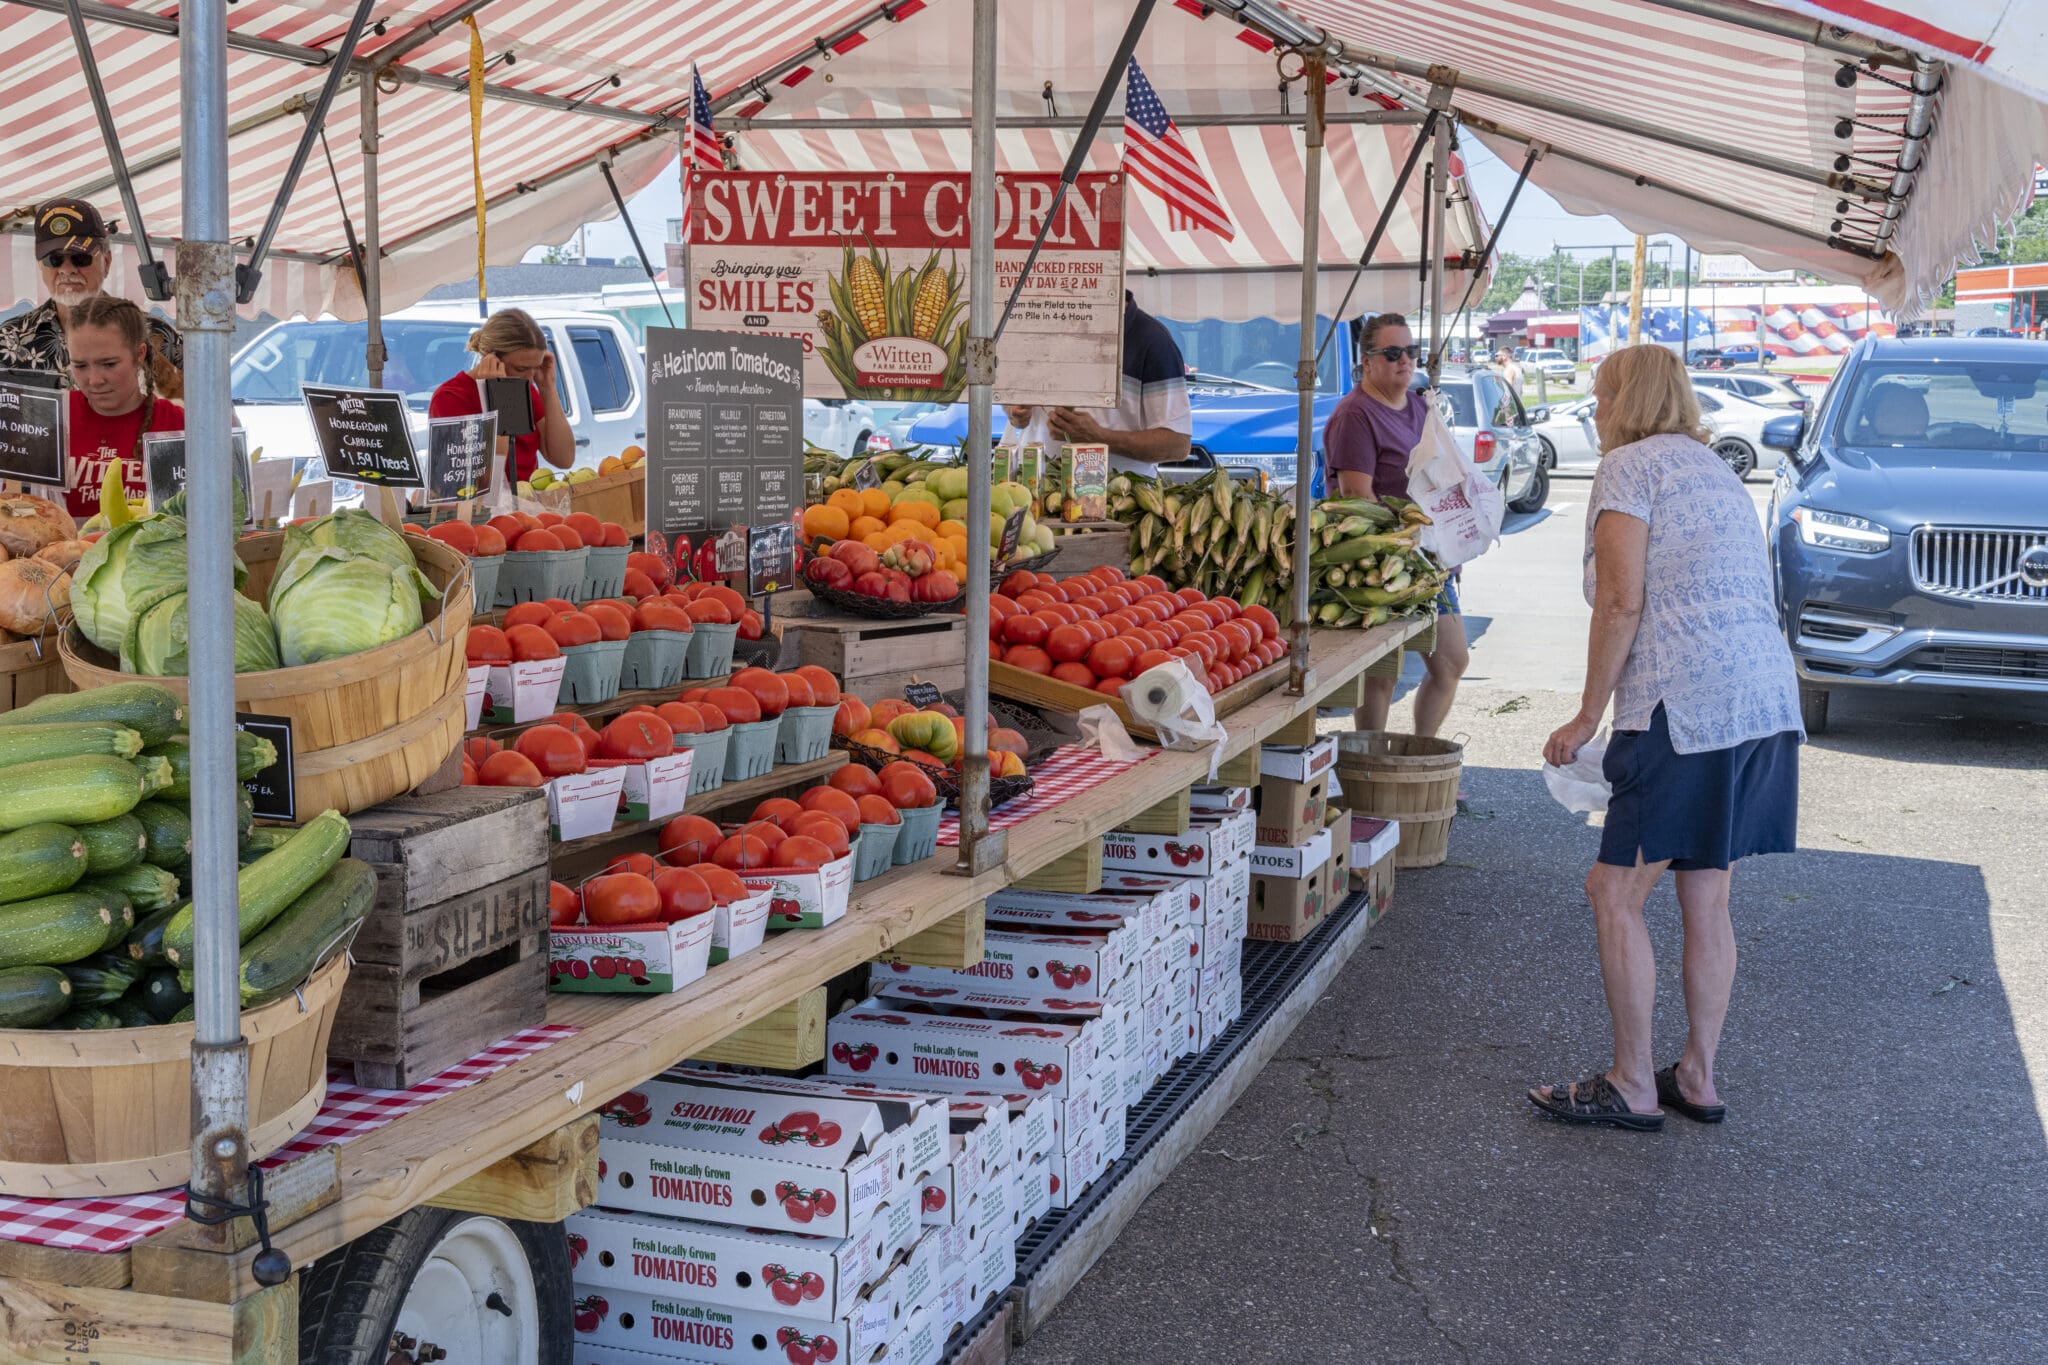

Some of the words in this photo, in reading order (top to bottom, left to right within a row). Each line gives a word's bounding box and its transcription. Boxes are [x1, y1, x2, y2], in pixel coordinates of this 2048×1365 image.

[703, 178, 906, 242] SWEET
[711, 260, 775, 278] Bringing
[776, 266, 802, 278] you
[1029, 262, 1066, 274] ICKED
[1068, 263, 1103, 274] FRESH
[1037, 277, 1058, 289] DAY
[1071, 278, 1078, 289] 2
[1080, 277, 1098, 289] AM
[699, 280, 814, 313] SMILES
[1004, 300, 1026, 308] Fom
[1028, 300, 1041, 309] the
[1044, 300, 1064, 309] Field
[1067, 301, 1076, 309] to
[1079, 301, 1092, 309] the
[747, 317, 766, 325] AND
[1025, 311, 1040, 320] Pile
[1043, 312, 1050, 320] in
[1052, 312, 1066, 320] 4-6
[1069, 312, 1093, 320] Hours
[872, 345, 933, 363] Witten
[663, 347, 726, 378] Heirloom
[730, 346, 791, 383] Tomatoes
[877, 374, 931, 385] Greenhouse
[0, 393, 19, 404] ITTEN
[668, 408, 702, 420] BRANDYWINE
[720, 410, 742, 420] HILLBILLY
[759, 411, 787, 421] CONESTOGA
[10, 422, 49, 437] ONIONS
[329, 417, 388, 432] HOMEGROWN
[343, 434, 383, 448] CABBAGE
[96, 446, 118, 459] THE
[1075, 452, 1106, 463] WHISTLE
[443, 469, 466, 483] $6.99
[671, 473, 699, 484] CHEROKEE
[719, 471, 743, 482] BERKELEY
[760, 471, 785, 480] MORTGAGE
[675, 484, 695, 495] PURPLE
[728, 483, 742, 492] DYED
[765, 481, 780, 491] LIFTER
[1256, 827, 1288, 844] ATOES
[1103, 844, 1137, 859] ATOES
[992, 908, 1053, 919] TOMATOES
[434, 879, 537, 967] PETERS
[550, 936, 582, 947] FARM
[584, 935, 623, 947] FRESH
[993, 950, 1013, 961] Grown
[963, 995, 1029, 1007] TOMATOES
[913, 1042, 931, 1054] Fresh
[932, 1045, 956, 1060] Locally
[957, 1048, 979, 1059] Grown
[912, 1056, 980, 1080] TOMATOES
[671, 1101, 757, 1125] TOMATOES
[664, 1118, 693, 1130] Grown
[693, 1120, 725, 1134] Locally
[725, 1125, 746, 1137] Fresh
[650, 1158, 673, 1173] Fresh
[674, 1161, 702, 1180] Locally
[704, 1166, 731, 1181] Grown
[649, 1175, 733, 1208] TOMATOES
[853, 1178, 880, 1203] Hillbilly
[632, 1238, 656, 1253] Fresh
[657, 1241, 687, 1260] Locally
[689, 1247, 716, 1262] Grown
[631, 1253, 717, 1288] TOMATOES
[652, 1300, 675, 1315] Fresh
[676, 1303, 704, 1322] Locally
[705, 1309, 732, 1324] Grown
[651, 1316, 734, 1350] TOMATOES
